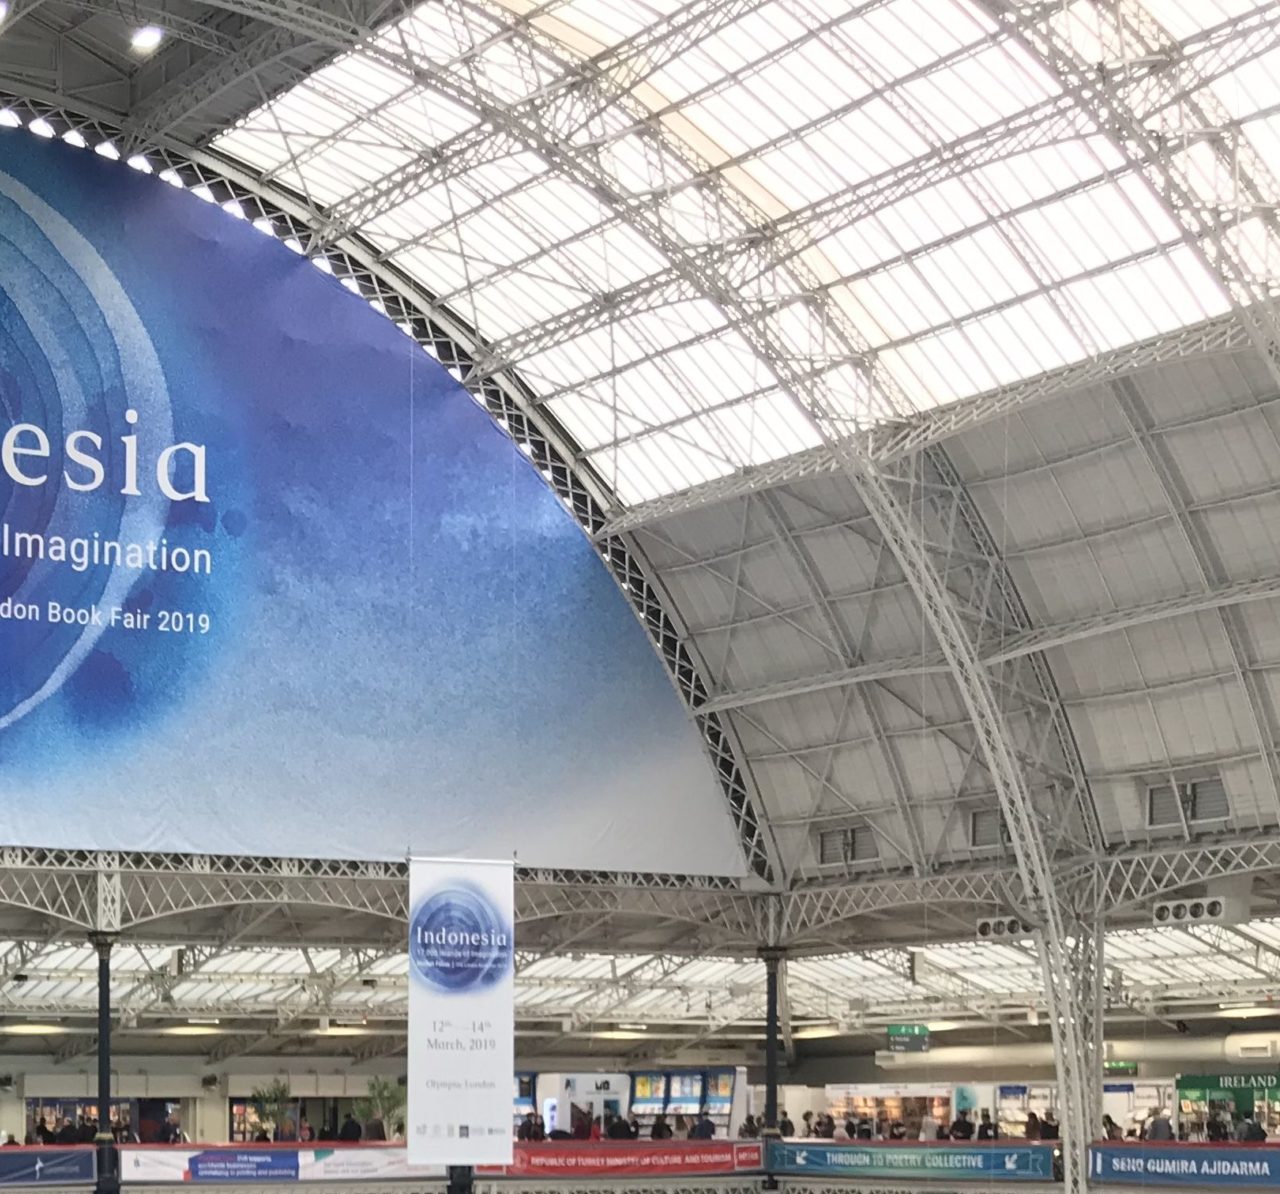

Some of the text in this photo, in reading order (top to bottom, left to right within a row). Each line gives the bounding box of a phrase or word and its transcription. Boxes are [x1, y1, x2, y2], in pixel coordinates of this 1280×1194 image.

[3, 523, 212, 574] Imagination
[48, 602, 103, 626] Book
[111, 607, 151, 630] Fair
[158, 611, 210, 634] 2019
[417, 926, 507, 946] Indonesia
[469, 1038, 496, 1050] 2019
[1220, 1075, 1277, 1088] IRELAND
[826, 1152, 870, 1166] THROUGH
[886, 1152, 922, 1168] POETRY
[925, 1153, 984, 1168] COLLECTIVE
[1147, 1160, 1197, 1174] GUMIRA
[1200, 1160, 1271, 1176] AJIDARMA
